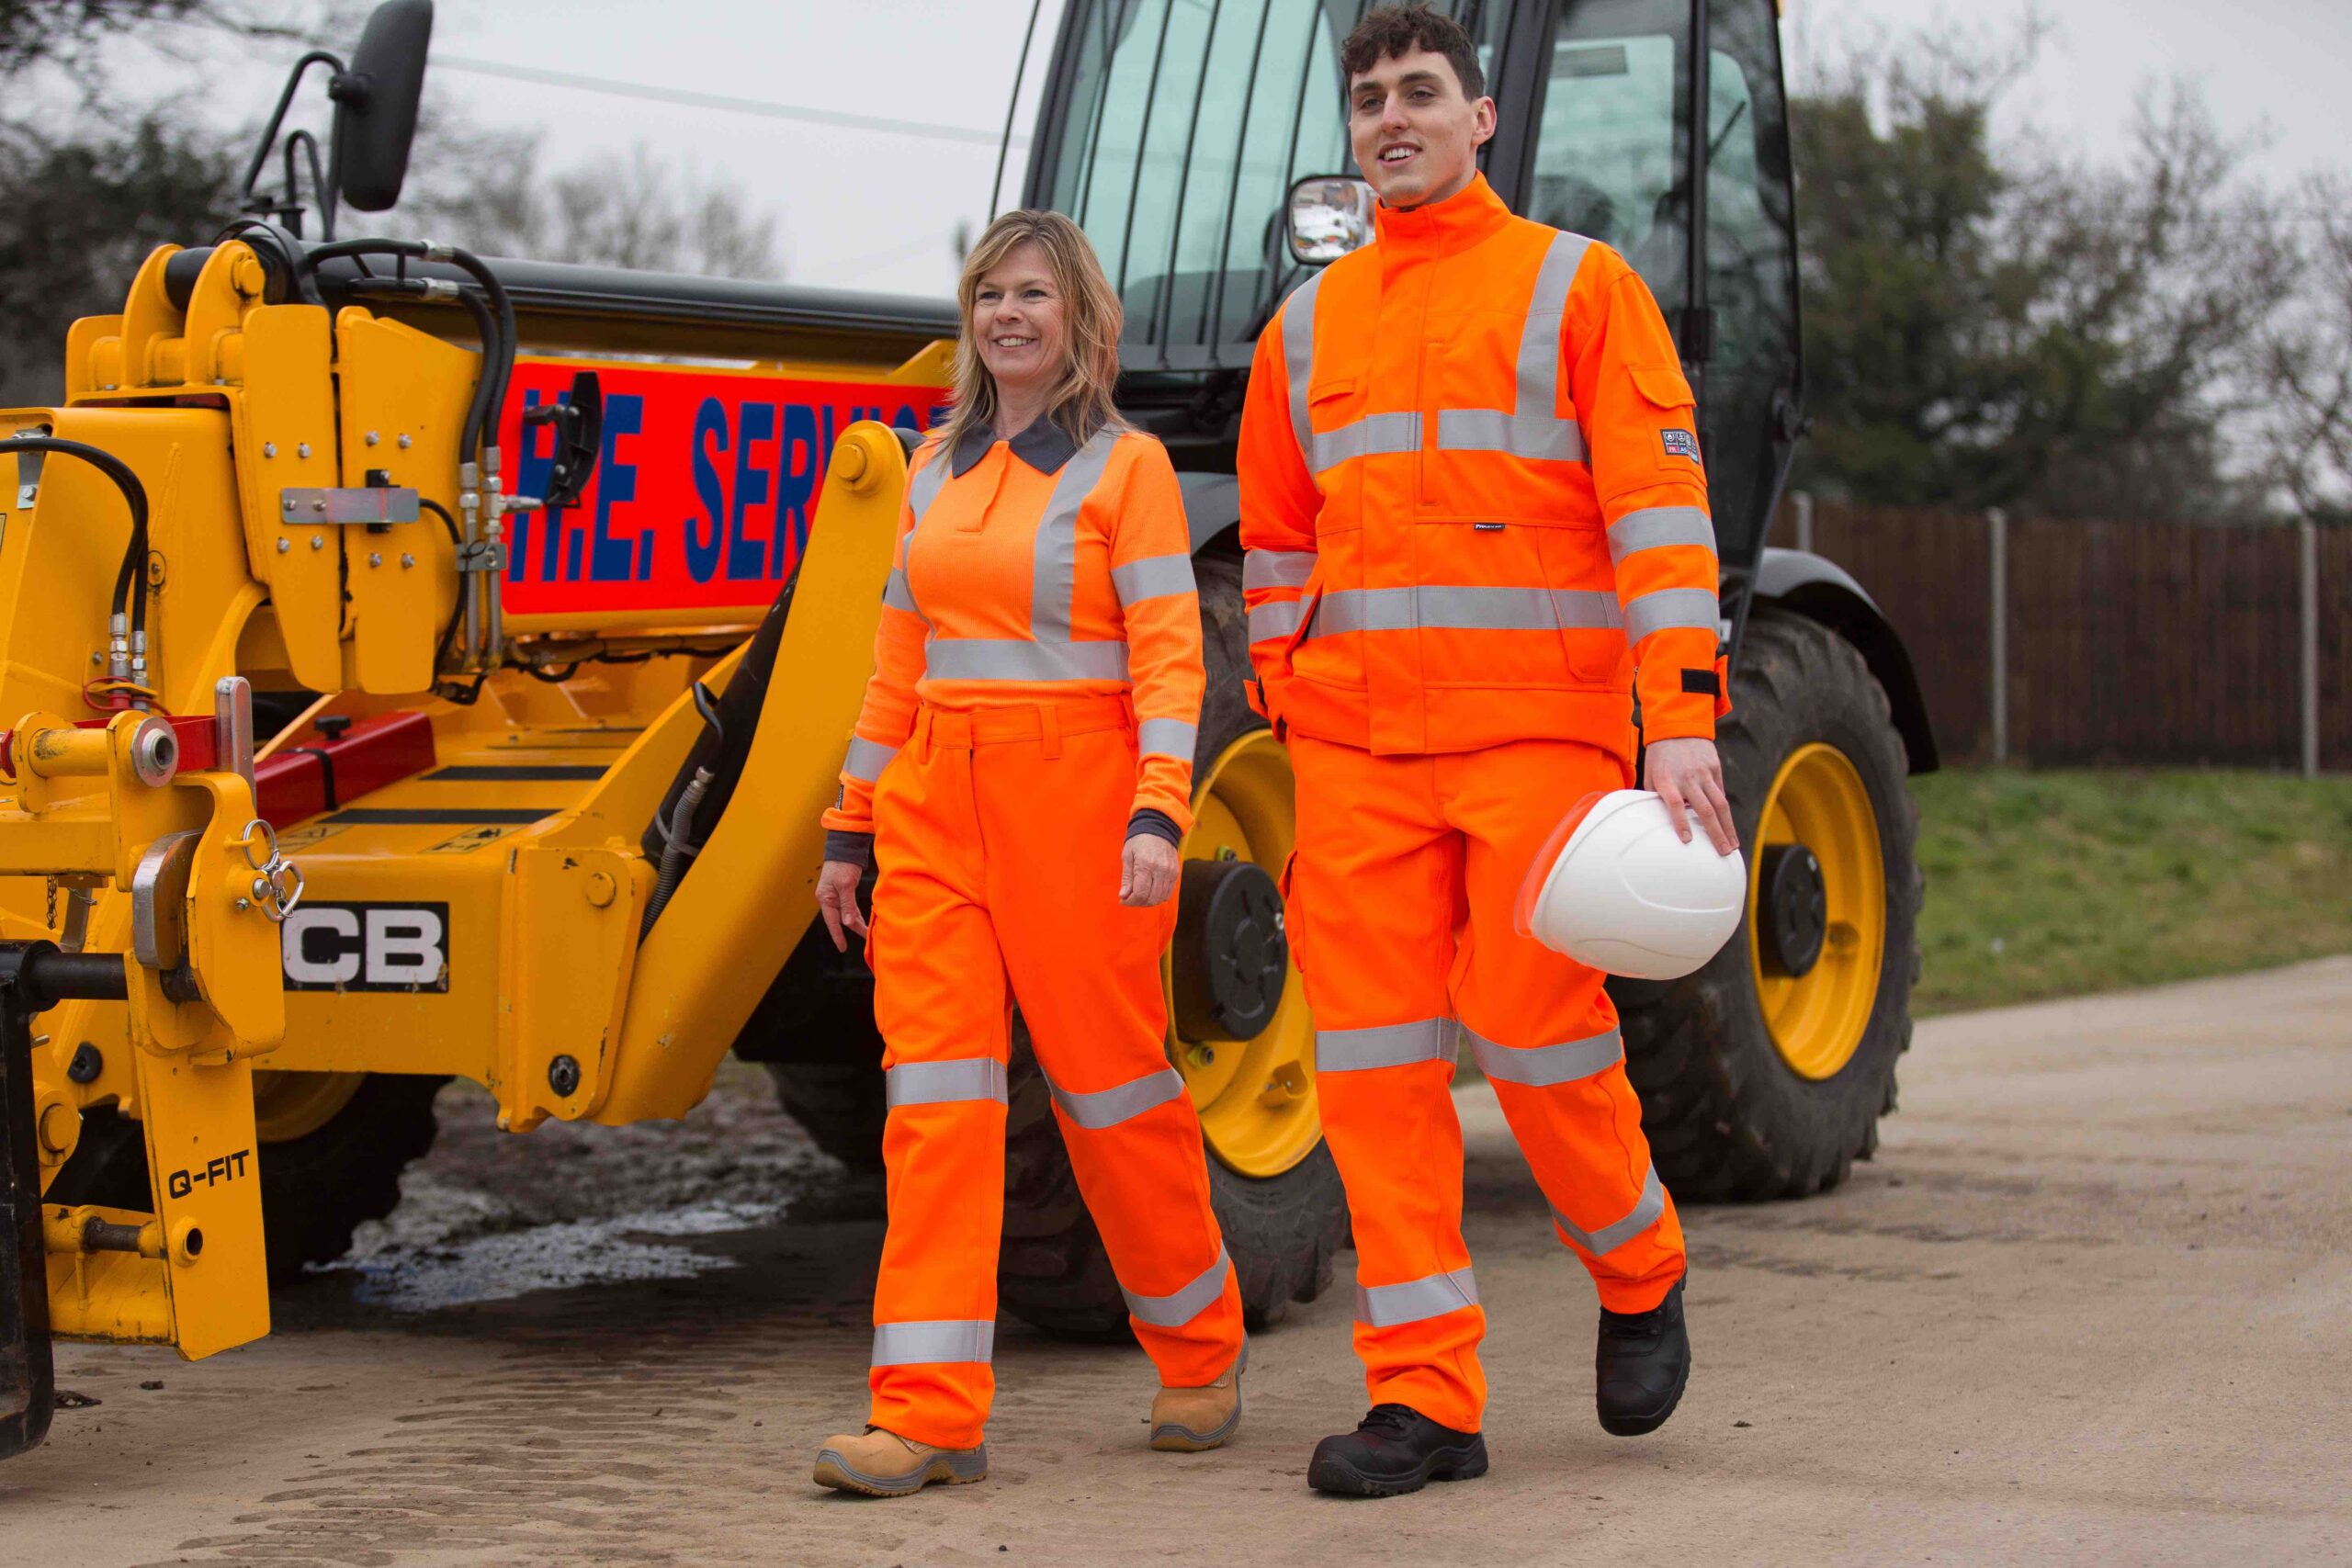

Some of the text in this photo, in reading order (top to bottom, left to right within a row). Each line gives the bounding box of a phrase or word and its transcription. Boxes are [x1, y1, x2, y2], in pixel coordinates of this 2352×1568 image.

[508, 389, 655, 582] H.E.
[282, 908, 445, 984] CB
[169, 1149, 250, 1200] Q-FIT
